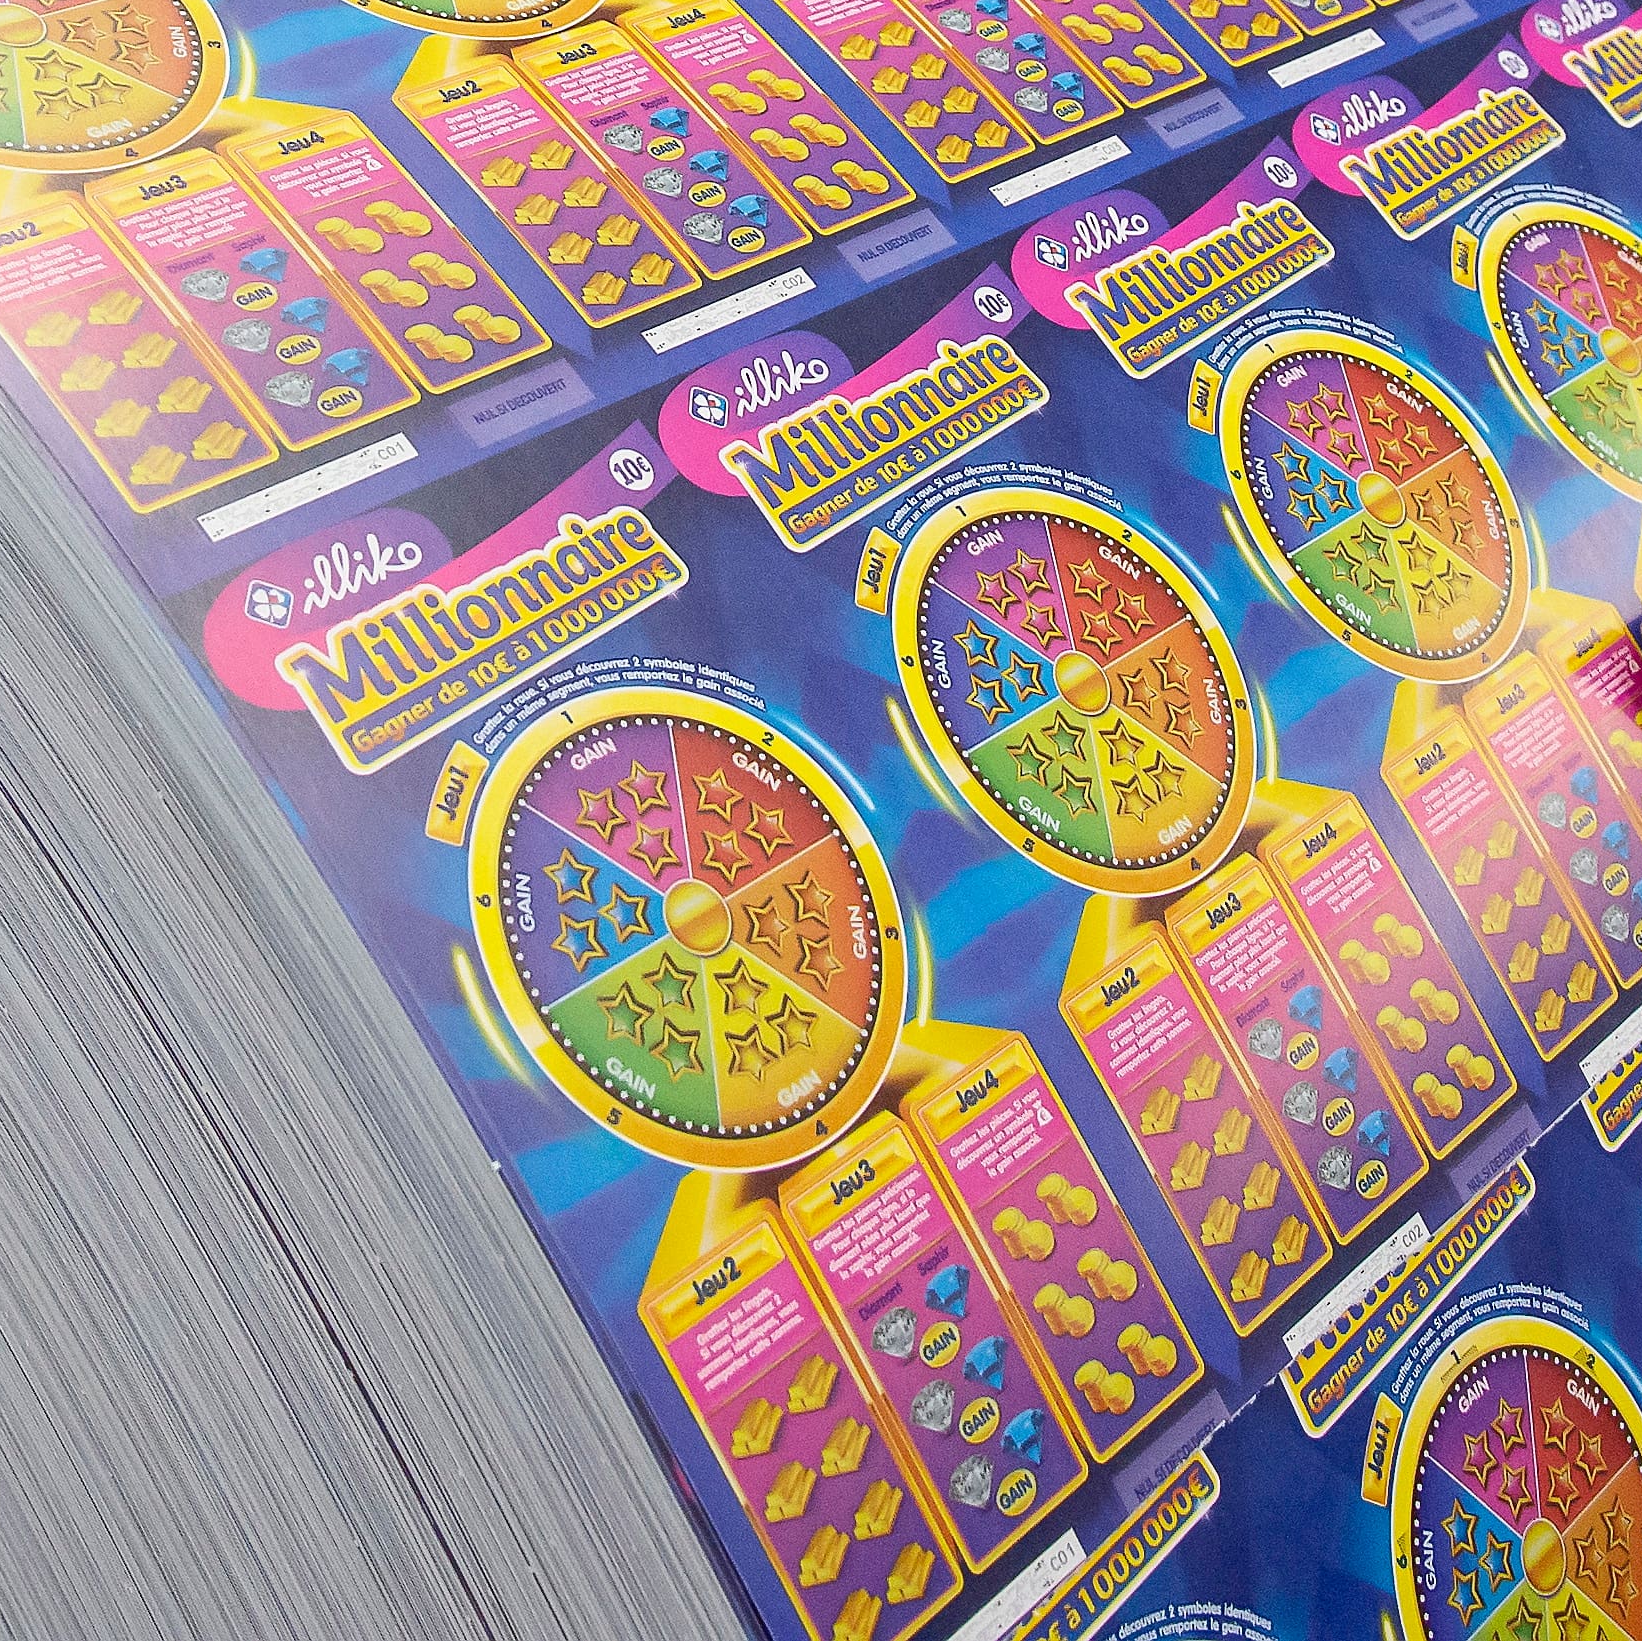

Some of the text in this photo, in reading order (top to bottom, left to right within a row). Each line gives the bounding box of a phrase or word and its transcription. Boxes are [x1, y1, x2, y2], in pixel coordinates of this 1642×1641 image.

[173, 25, 185, 58] GAIN
[87, 118, 132, 139] GAIN
[1343, 96, 1407, 139] illiko
[1347, 85, 1539, 202] Millionnaire
[1268, 161, 1296, 184] 10€
[1075, 206, 1150, 263] illiko
[1075, 202, 1305, 341] Millionnaire
[236, 286, 273, 308] GAIN
[977, 292, 1009, 317] 10€
[1126, 327, 1179, 363] Gagner
[1179, 313, 1199, 333] de
[1197, 299, 1229, 324] 10€
[1226, 290, 1236, 306] à
[734, 350, 830, 418] illiko
[732, 342, 1017, 510] Millionnaire
[377, 442, 405, 461] C01
[614, 455, 651, 484] 10€
[787, 488, 854, 534] Gagner
[853, 473, 879, 499] de
[877, 455, 915, 484] 10€
[913, 444, 927, 463] à
[966, 529, 1005, 557] GAIN
[1097, 545, 1141, 581] GAIN
[304, 534, 423, 614] illiko
[290, 512, 654, 725] Millionnaire
[936, 639, 951, 689] GAIN
[351, 697, 435, 751] Gagner
[439, 678, 468, 705] de
[468, 656, 515, 690] 10€
[514, 640, 531, 660] à
[473, 711, 505, 744] Grattez
[514, 688, 538, 710] roue.
[538, 679, 549, 691] Si
[550, 670, 574, 685] vous
[576, 658, 630, 676] découvrez
[632, 656, 641, 667] 2
[643, 657, 696, 673] symboles
[697, 662, 755, 692] identiques
[484, 732, 505, 754] dans
[504, 719, 517, 733] un
[516, 700, 547, 721] même
[594, 673, 620, 684] vous
[622, 669, 680, 683] remportez
[695, 675, 721, 692] gain
[1210, 677, 1223, 725] GAIN
[569, 737, 618, 771] GAIN
[730, 751, 784, 793] GAIN
[1017, 795, 1062, 833] GAIN
[1157, 816, 1192, 845] GAIN
[518, 872, 535, 932] GAIN
[851, 904, 868, 960] GAIN
[605, 1055, 656, 1101] GAIN
[776, 1069, 822, 1109] GAIN
[1401, 1223, 1425, 1249] C02
[1306, 1349, 1368, 1413] Gagner
[1365, 1327, 1387, 1353] de
[1384, 1290, 1421, 1330] 10€
[1416, 1278, 1429, 1299] à
[1391, 1282, 1582, 1394] Grattez la roue. Si vous découvrez 2 symboles identiques
[1400, 1379, 1415, 1404] dans
[1412, 1362, 1422, 1378] un
[1420, 1340, 1441, 1366] même
[1473, 1304, 1491, 1316] vous
[1492, 1297, 1531, 1311] remportez
[1532, 1297, 1541, 1309] le
[1542, 1302, 1560, 1315] gain
[1458, 1375, 1490, 1413] GAIN
[1565, 1379, 1600, 1417] GAIN
[1049, 1543, 1076, 1573] C01
[1423, 1529, 1437, 1591] GAIN
[1065, 1603, 1081, 1629] à
